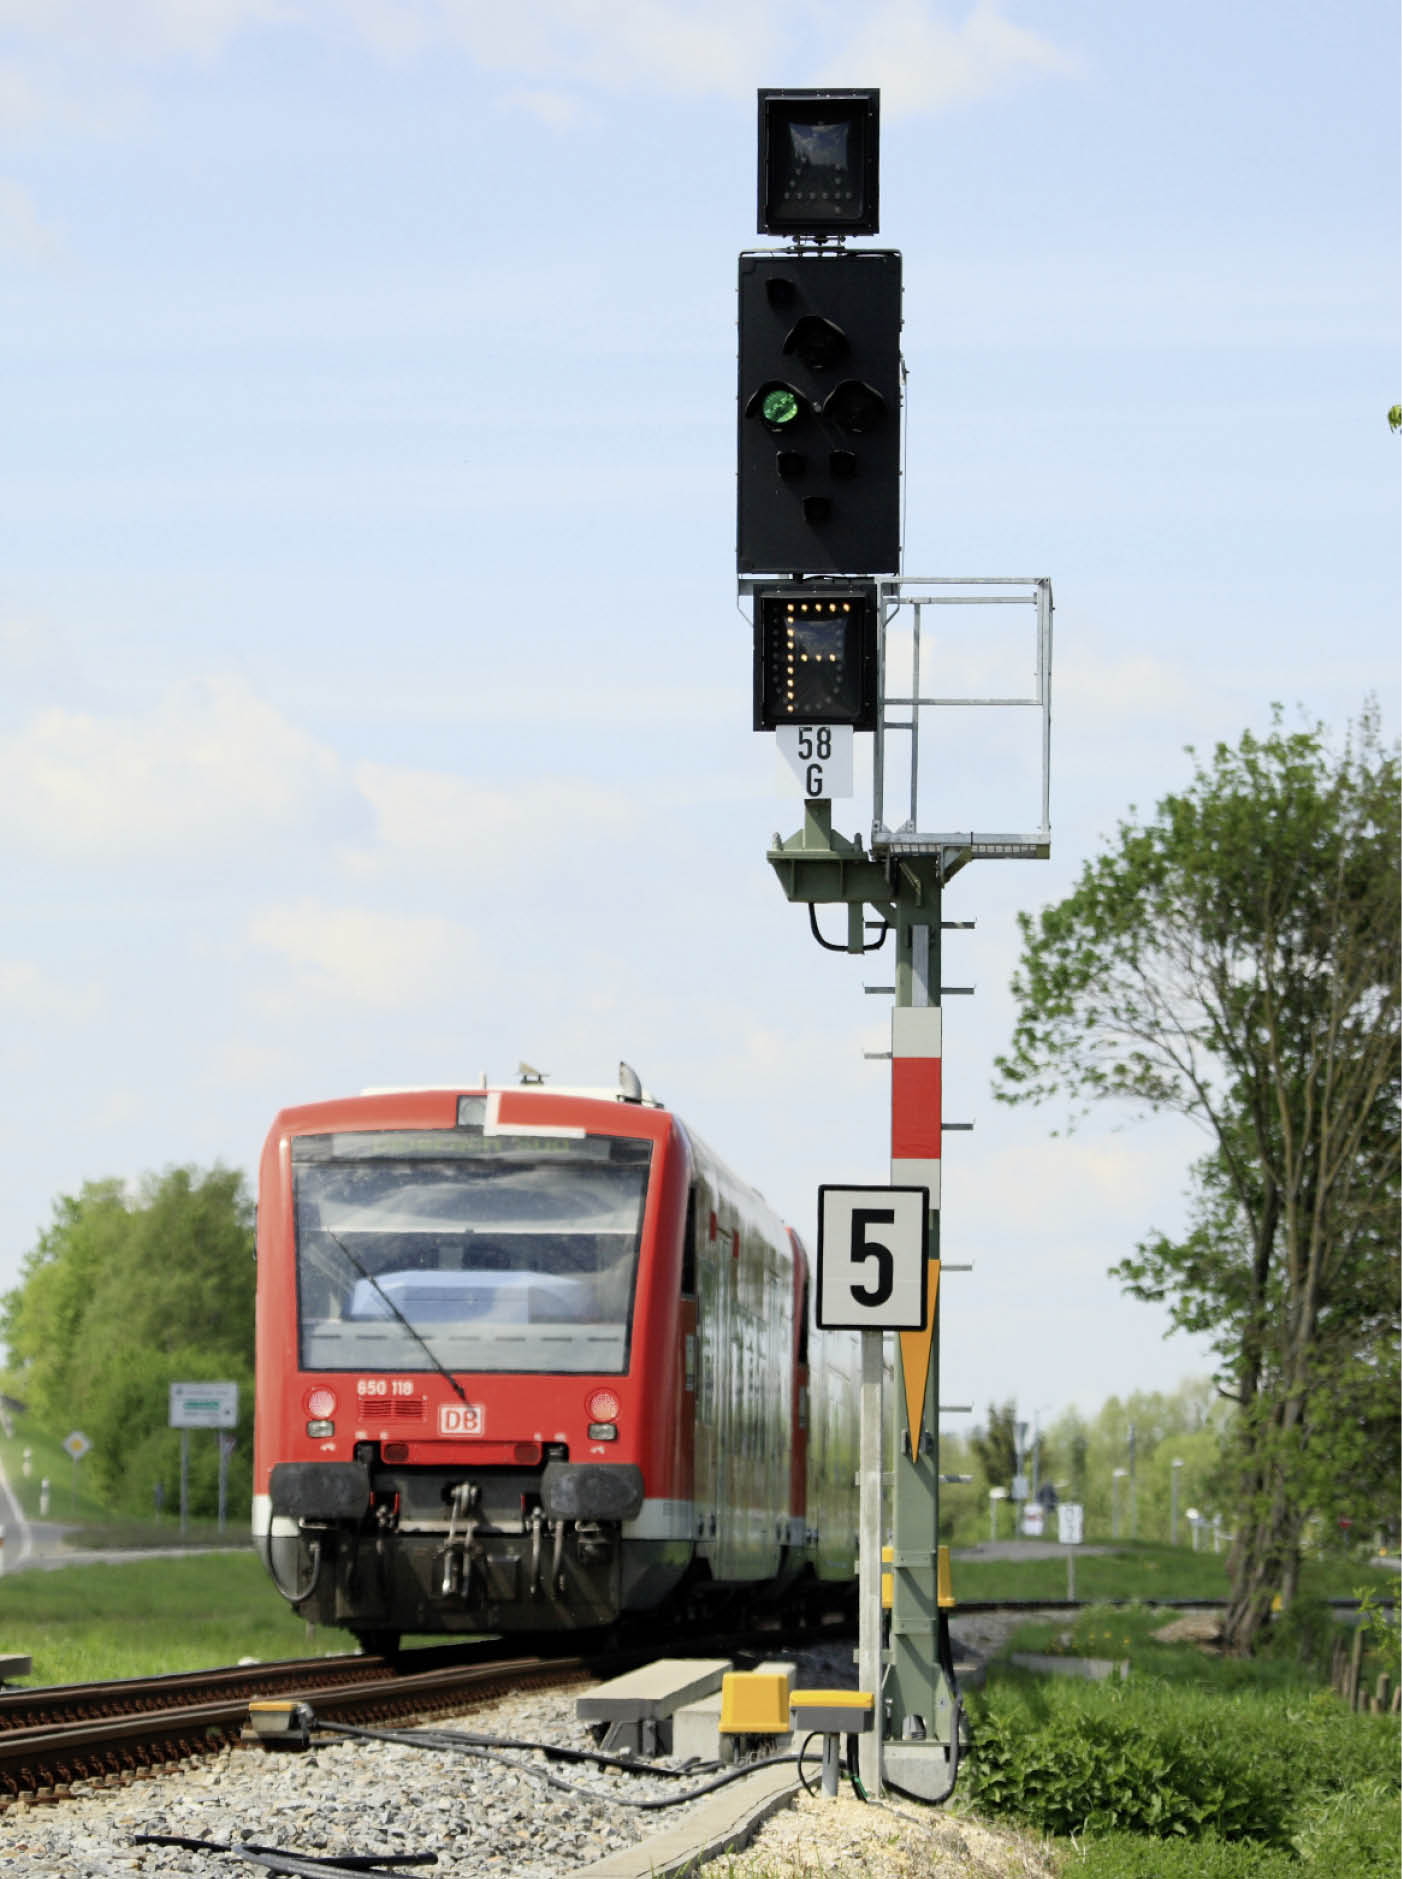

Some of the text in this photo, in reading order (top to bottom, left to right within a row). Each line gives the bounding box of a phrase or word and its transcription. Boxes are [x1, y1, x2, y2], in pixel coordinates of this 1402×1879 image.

[787, 603, 850, 712] F
[798, 726, 832, 760] 58
[806, 763, 823, 797] G
[850, 1209, 895, 1307] 5
[357, 1379, 387, 1396] 650
[444, 1408, 479, 1432] DB
